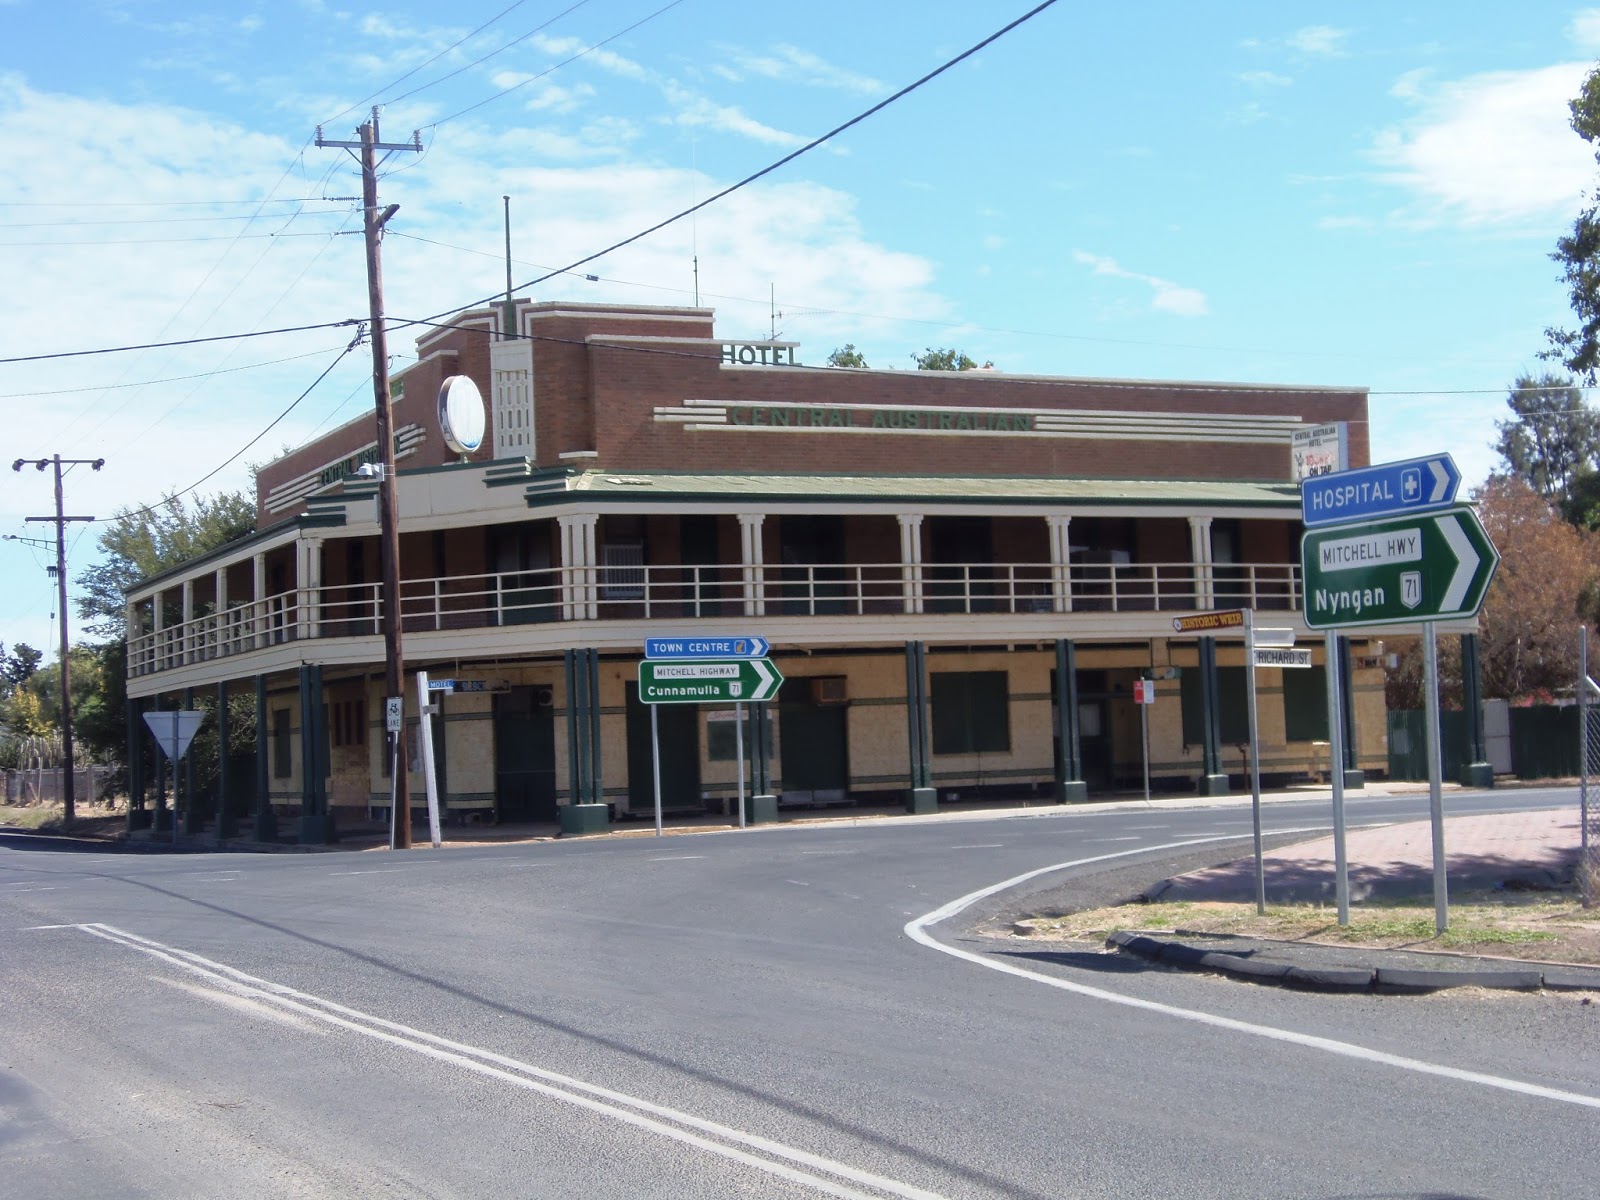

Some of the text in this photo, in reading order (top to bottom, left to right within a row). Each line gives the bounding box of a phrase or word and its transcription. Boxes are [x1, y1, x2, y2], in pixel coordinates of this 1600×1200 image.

[720, 344, 802, 366] HOTEL
[732, 406, 1031, 431] CENTRAL AUSTRALIAN
[1294, 426, 1336, 440] CENTRAL AUSTRALIAN
[1309, 438, 1322, 447] HOTEL
[1320, 465, 1332, 475] TAP
[1312, 480, 1394, 511] HOSPITAL
[1322, 536, 1417, 565] MITCHELL HWY
[1405, 578, 1418, 599] 71
[1315, 586, 1385, 615] Nyngan
[1181, 613, 1243, 629] HISTORIC WEIR
[653, 642, 730, 653] TOWN CENTRE
[1258, 651, 1309, 664] RICHARD ST
[656, 667, 737, 676] MITCHELL HIGHWAY
[647, 685, 721, 696] Cunnamulla
[731, 684, 740, 693] 71
